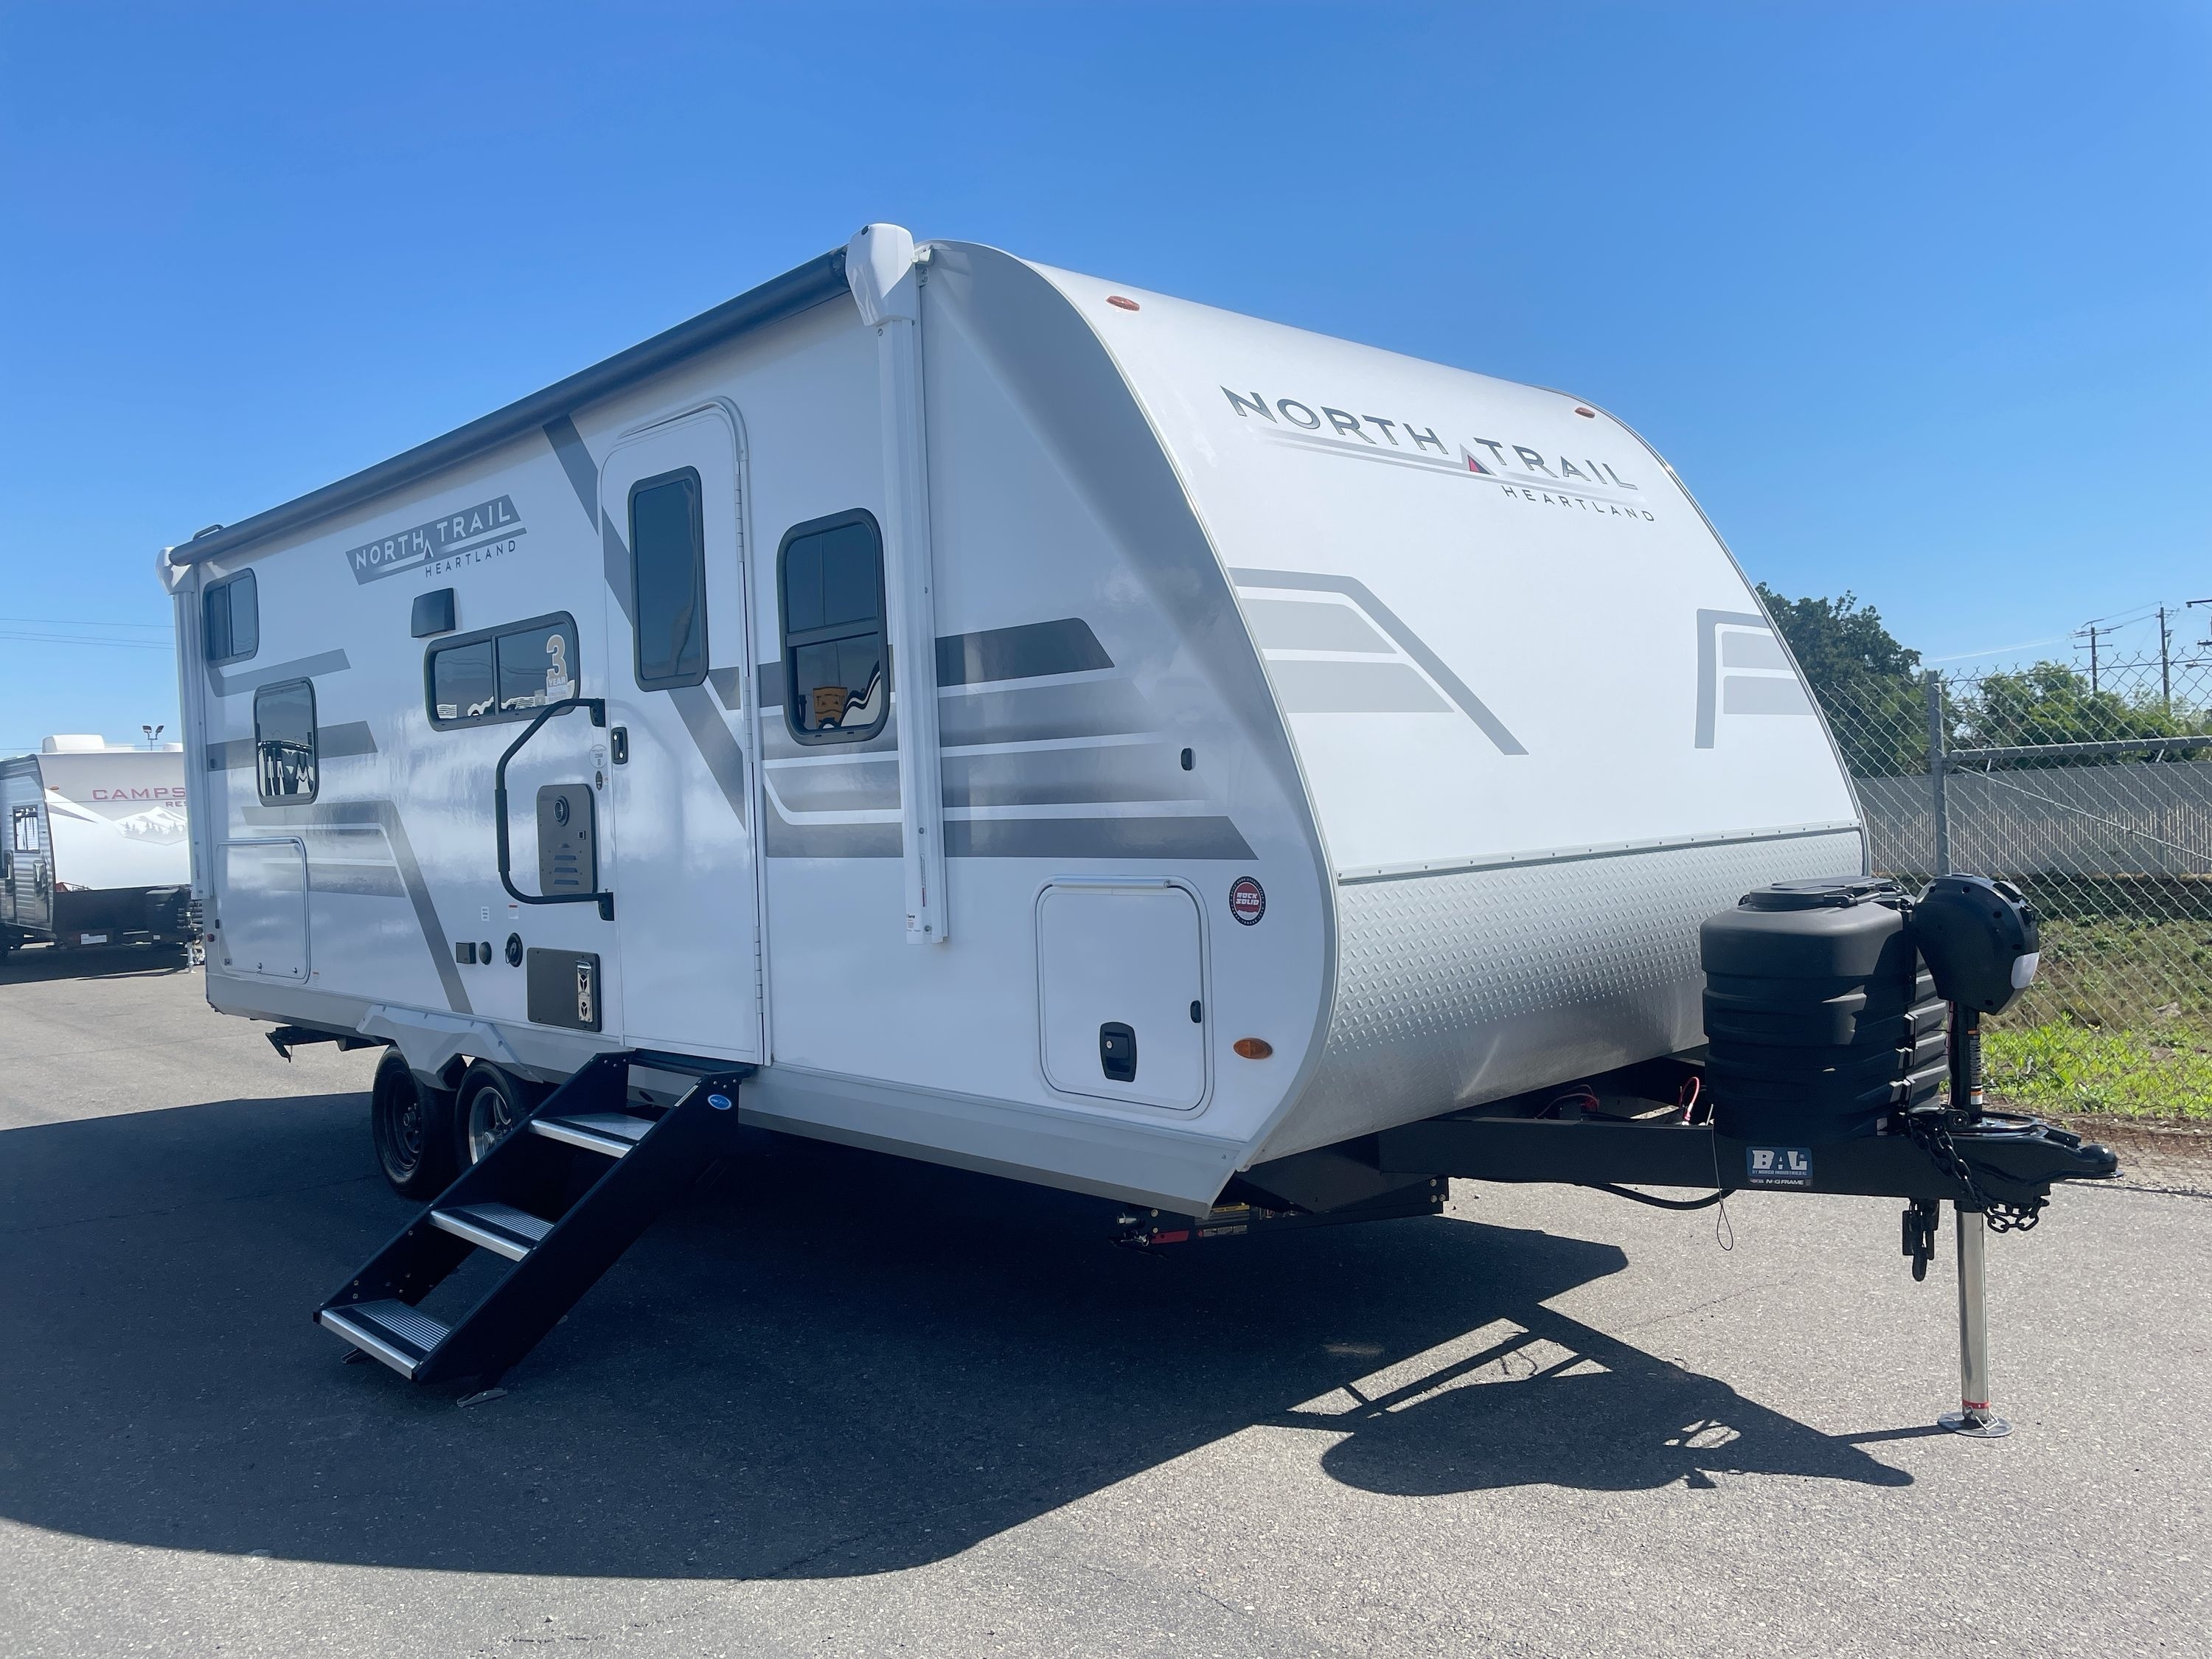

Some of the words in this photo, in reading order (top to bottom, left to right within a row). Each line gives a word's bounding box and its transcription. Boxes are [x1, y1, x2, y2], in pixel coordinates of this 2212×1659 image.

[1220, 385, 1450, 455] NORTH
[1473, 437, 1638, 490] TRAIL
[1501, 485, 1655, 522] HEARTLAND
[355, 529, 425, 570] NORTH
[437, 501, 511, 542] TRAIL
[425, 540, 516, 578] HEARTLAND
[546, 634, 566, 678] 3
[548, 676, 566, 686] YEAR
